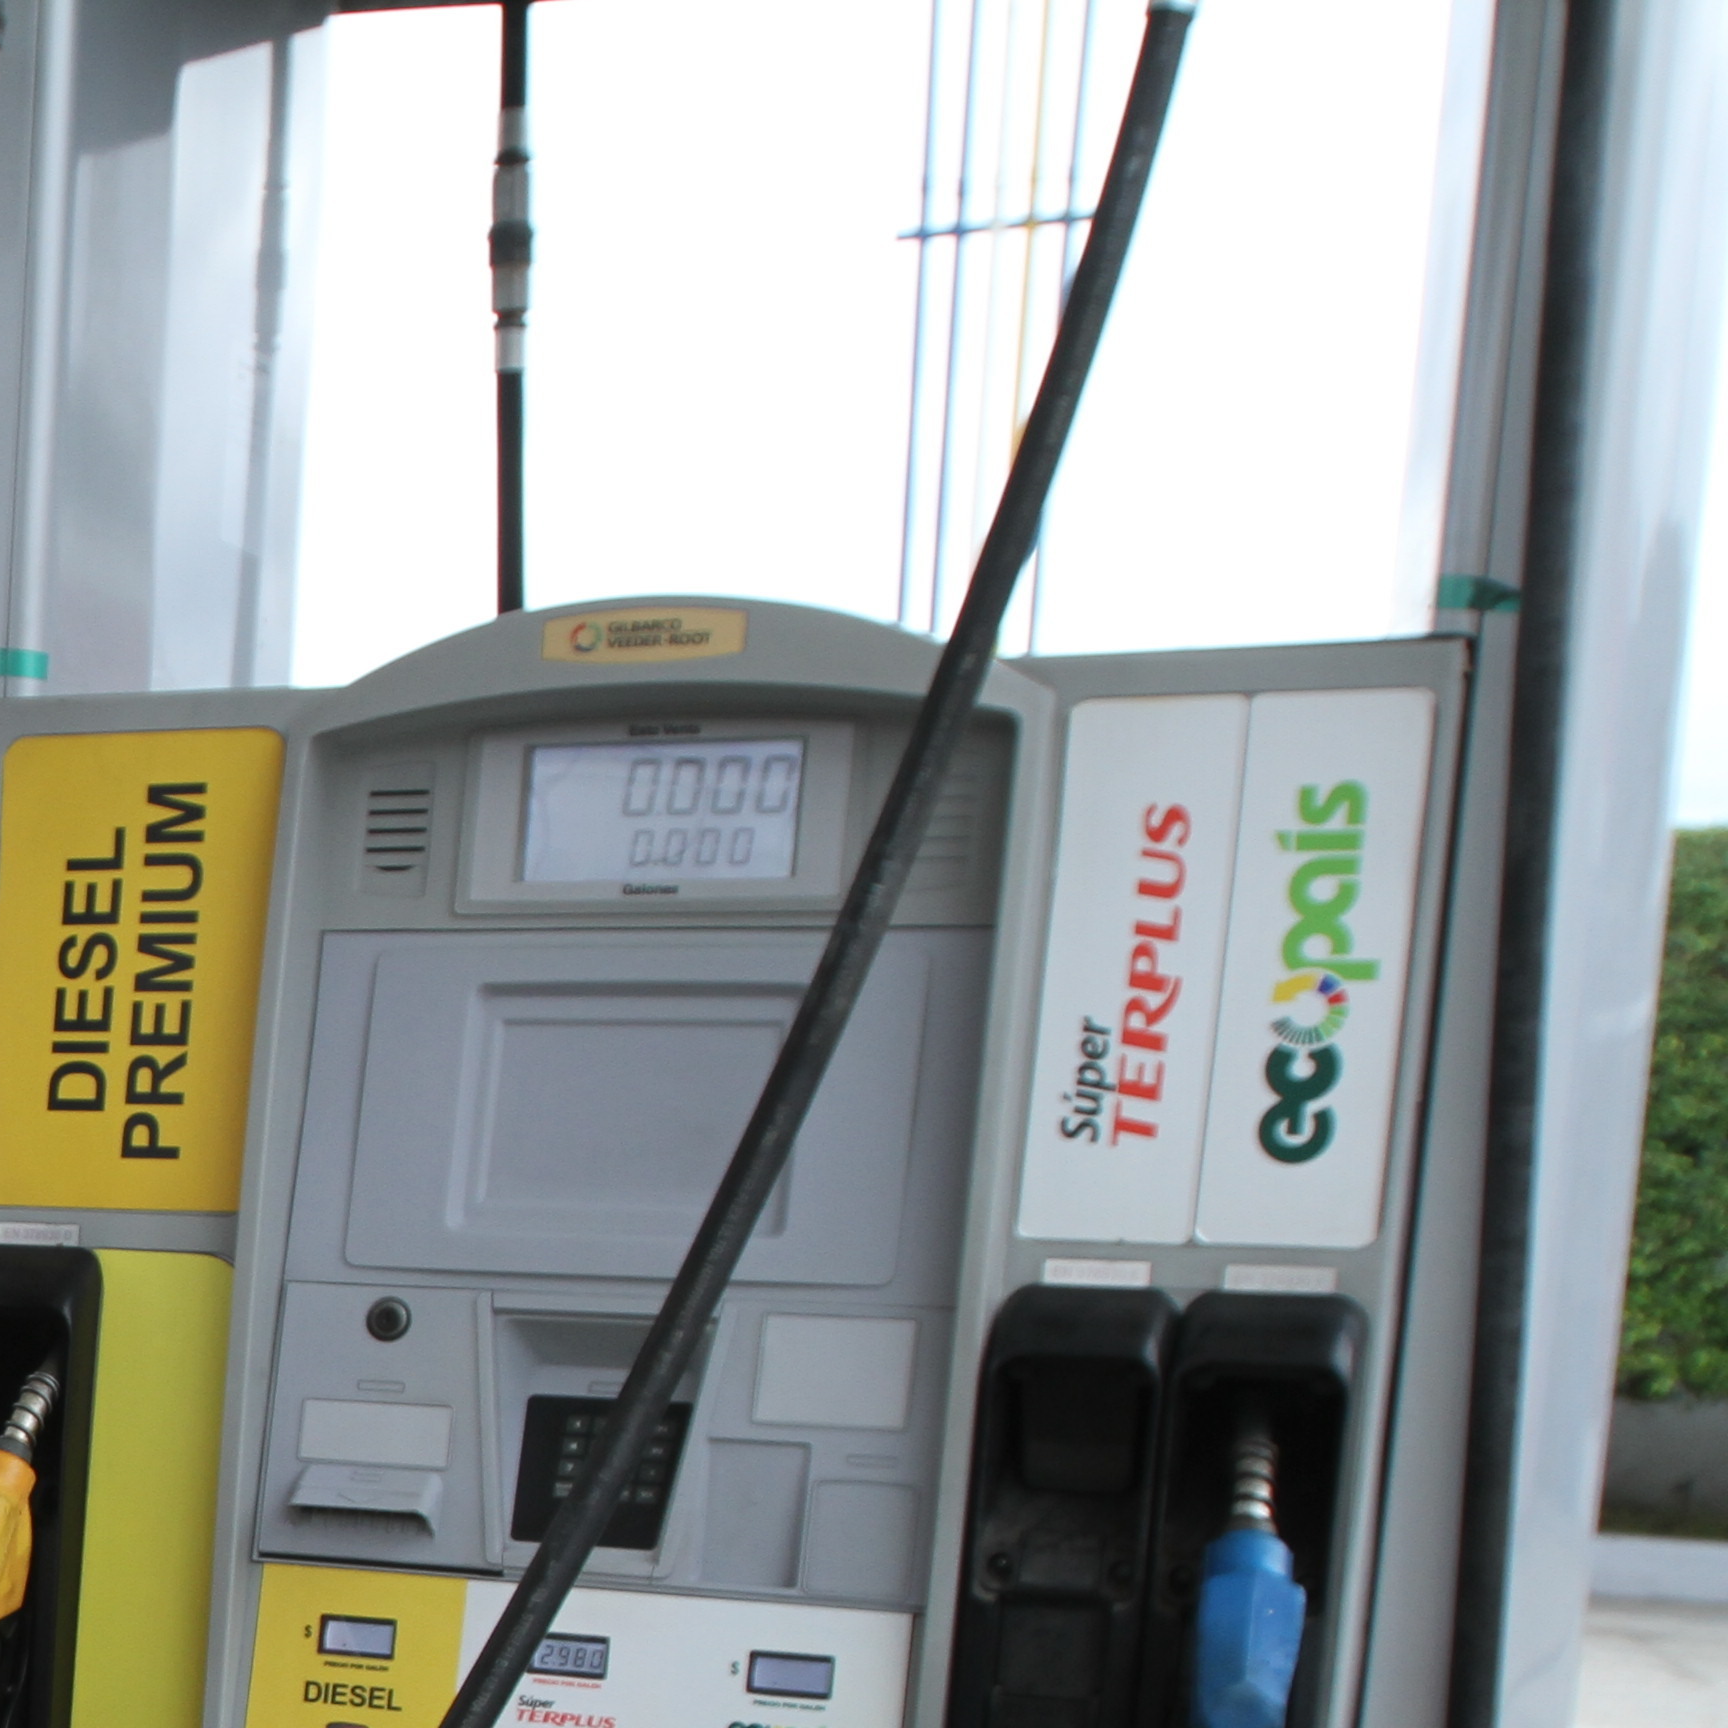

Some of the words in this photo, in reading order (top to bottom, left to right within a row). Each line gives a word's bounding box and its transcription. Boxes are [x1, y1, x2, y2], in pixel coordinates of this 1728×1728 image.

[607, 618, 682, 633] GILBARCO
[47, 825, 127, 1114] DIESEL
[120, 781, 209, 1160] PREMIUM
[1110, 801, 1193, 1147] TERPLUS
[1060, 1015, 1114, 1144] Súper
[303, 1680, 402, 1712] DIESEL
[518, 1694, 555, 1711] Súper
